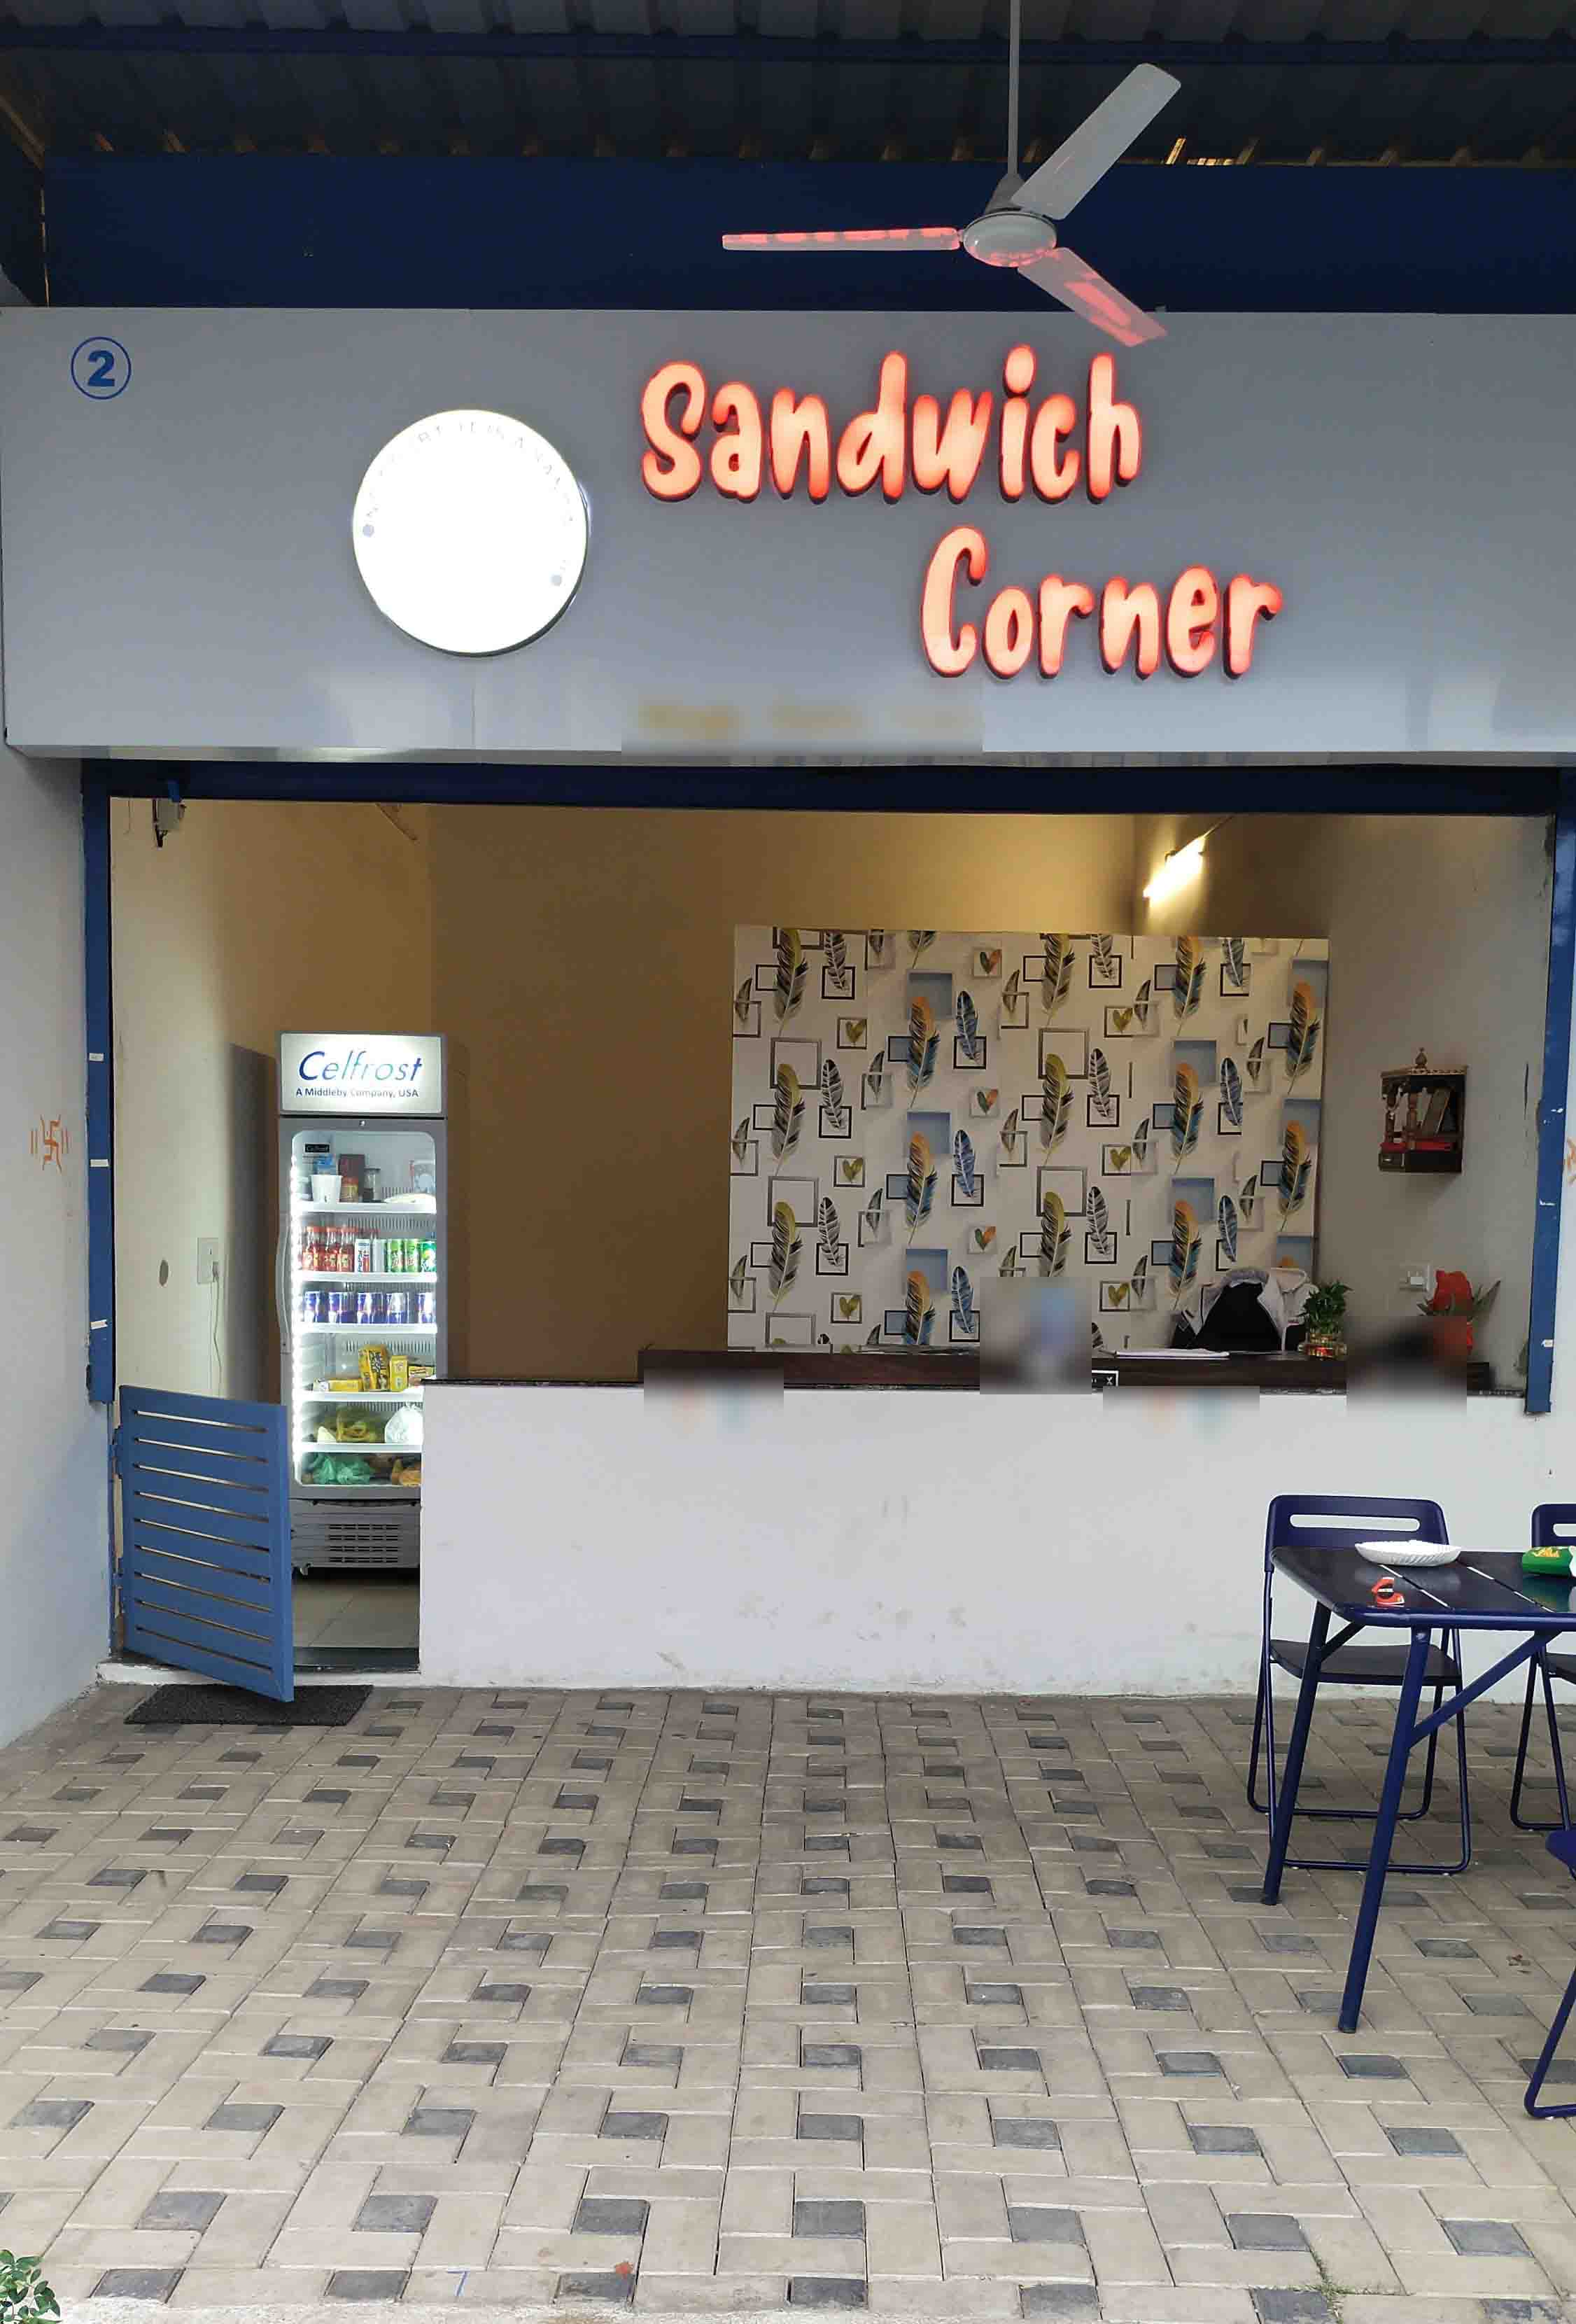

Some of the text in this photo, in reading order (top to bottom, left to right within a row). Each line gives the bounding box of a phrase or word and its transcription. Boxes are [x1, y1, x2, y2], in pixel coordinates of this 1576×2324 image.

[87, 350, 115, 387] 2
[641, 344, 1142, 504] Sandwich
[921, 525, 1283, 680] Corner
[298, 1049, 423, 1082] Celfrost
[295, 1087, 419, 1098] A Middleby Company, USA
